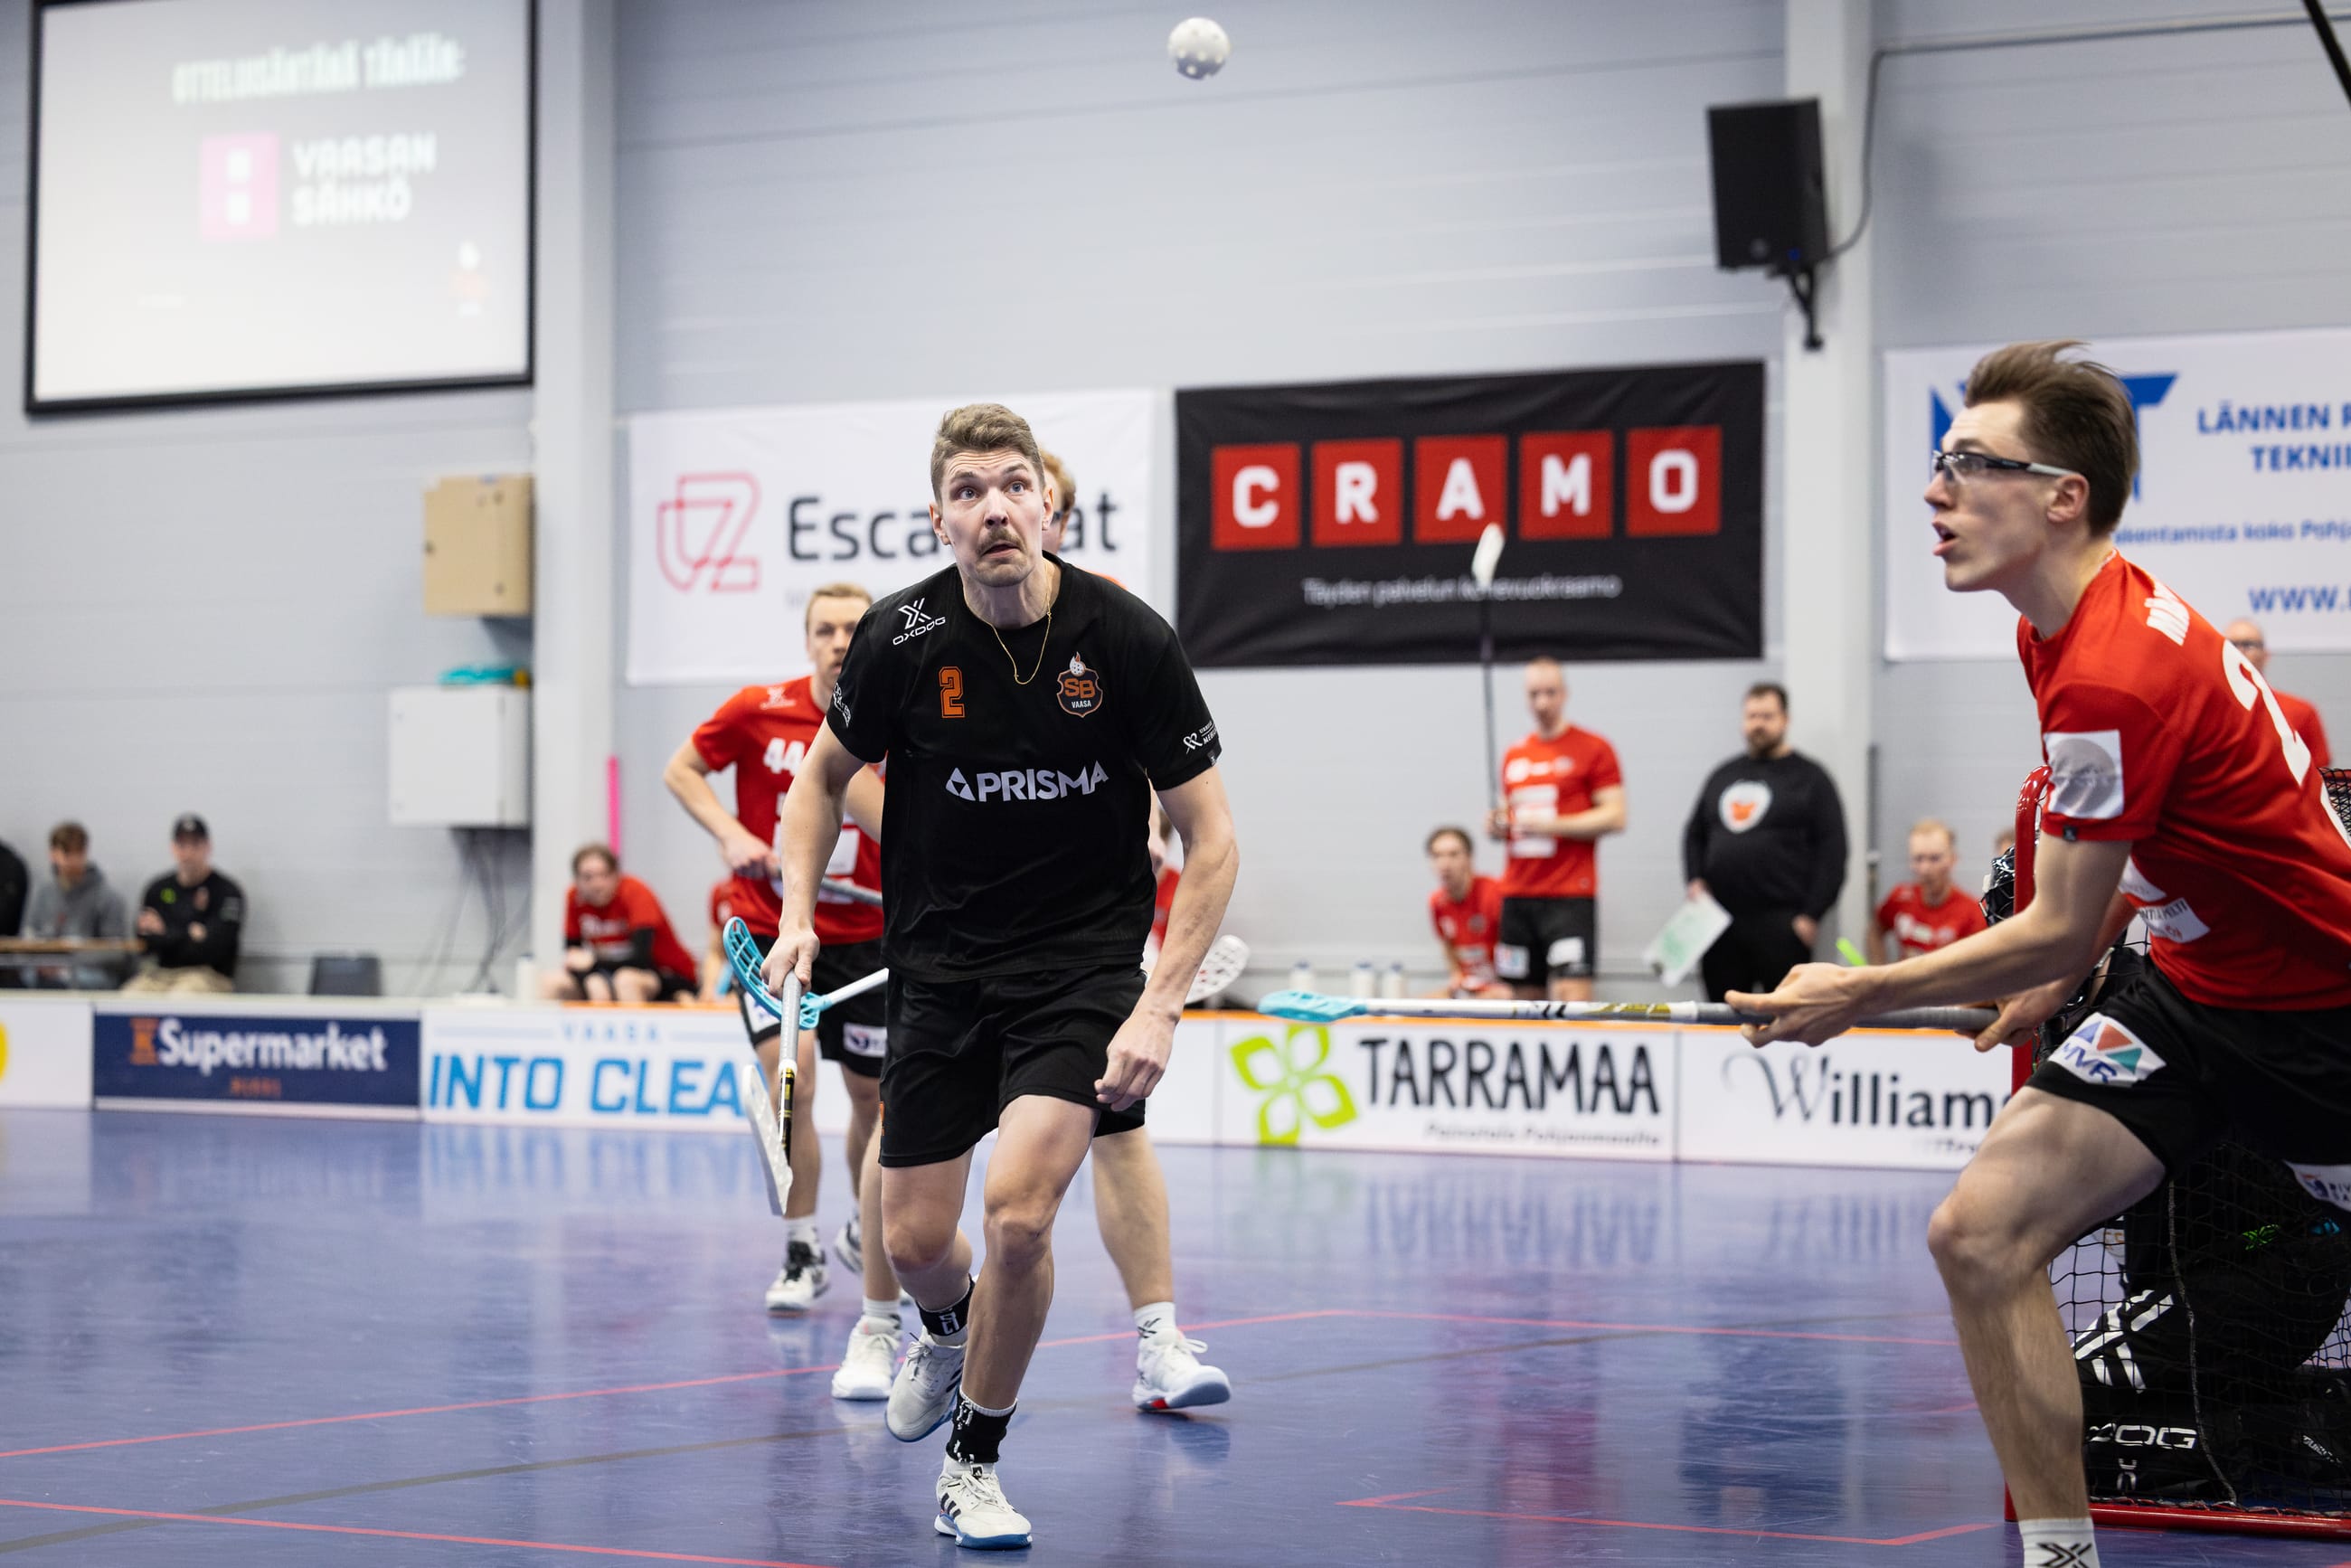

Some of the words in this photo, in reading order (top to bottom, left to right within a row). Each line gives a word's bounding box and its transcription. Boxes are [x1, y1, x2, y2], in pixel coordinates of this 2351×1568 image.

[291, 133, 437, 178] VAASAN
[291, 175, 412, 225] SÄHKÖ
[2196, 401, 2330, 435] LÄNNEN
[1232, 449, 1700, 528] CRAMO
[788, 490, 1119, 561] Escaat
[892, 616, 946, 646] OXDOG
[939, 666, 965, 719] 2
[1064, 677, 1096, 699] SB
[1071, 699, 1092, 708] VAASA
[763, 737, 807, 777] 44
[976, 760, 1109, 803] PRISMA
[158, 1018, 389, 1077] Supermarket
[429, 1054, 565, 1111] INTO
[590, 1057, 769, 1118] CLEA
[1358, 1039, 1661, 1114] TARRAMAA
[1721, 1049, 2013, 1129] William
